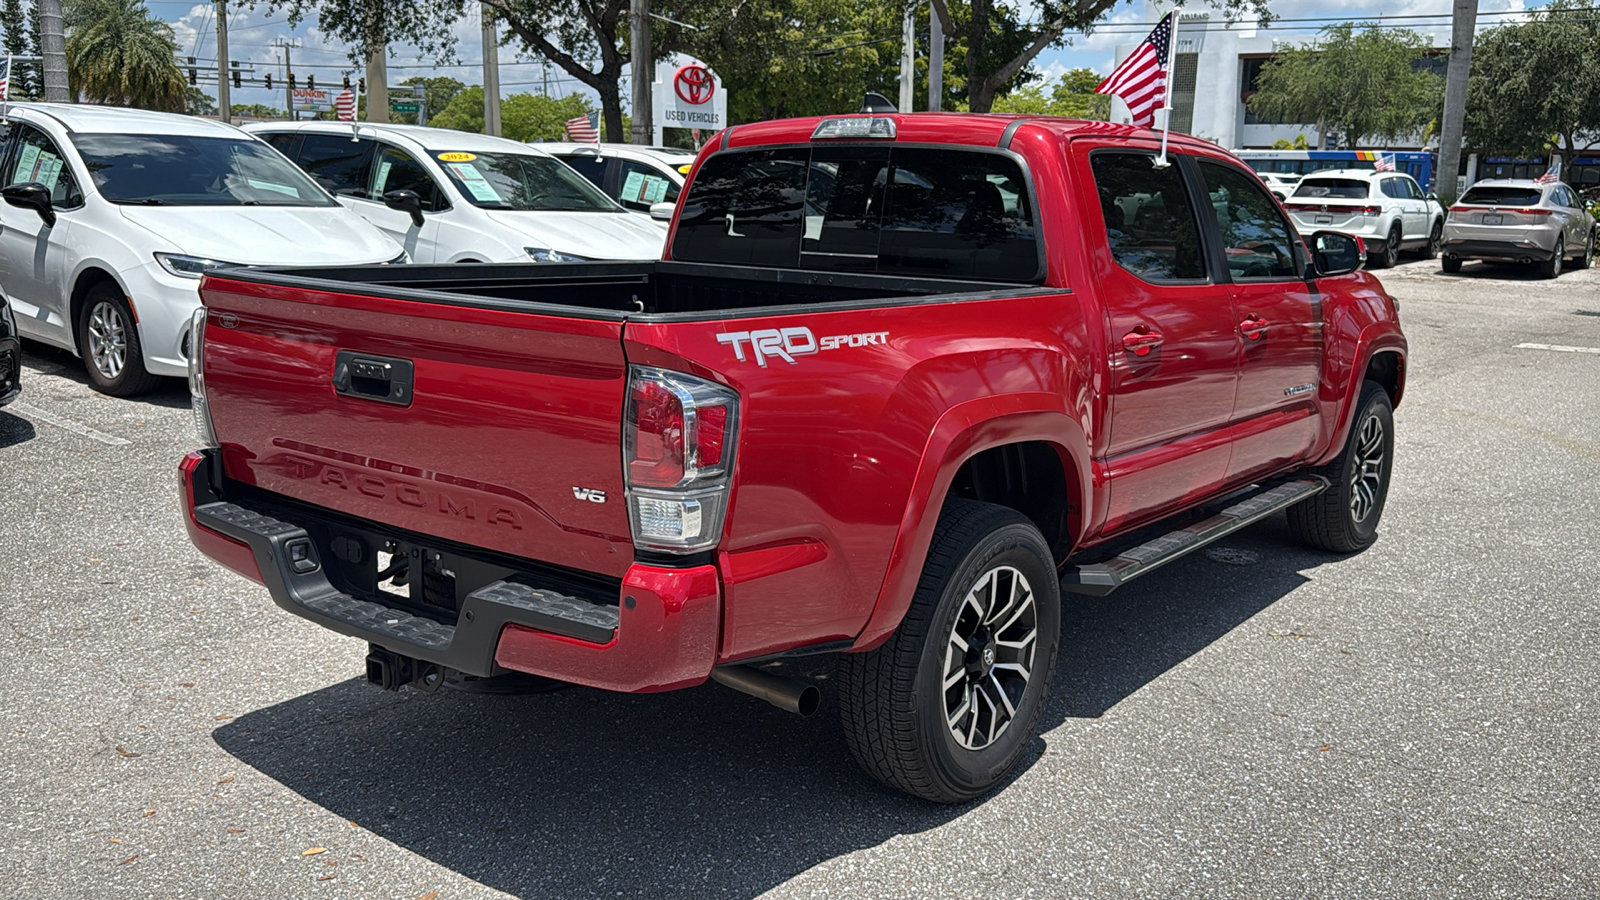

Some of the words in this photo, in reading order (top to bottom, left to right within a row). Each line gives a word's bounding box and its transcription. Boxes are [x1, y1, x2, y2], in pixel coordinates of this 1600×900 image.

[665, 109, 686, 121] USED
[687, 111, 719, 124] VEHICLES
[715, 326, 819, 369] TRD
[820, 331, 890, 351] SPORT
[286, 456, 523, 530] TACOMA
[572, 486, 606, 504] V6
